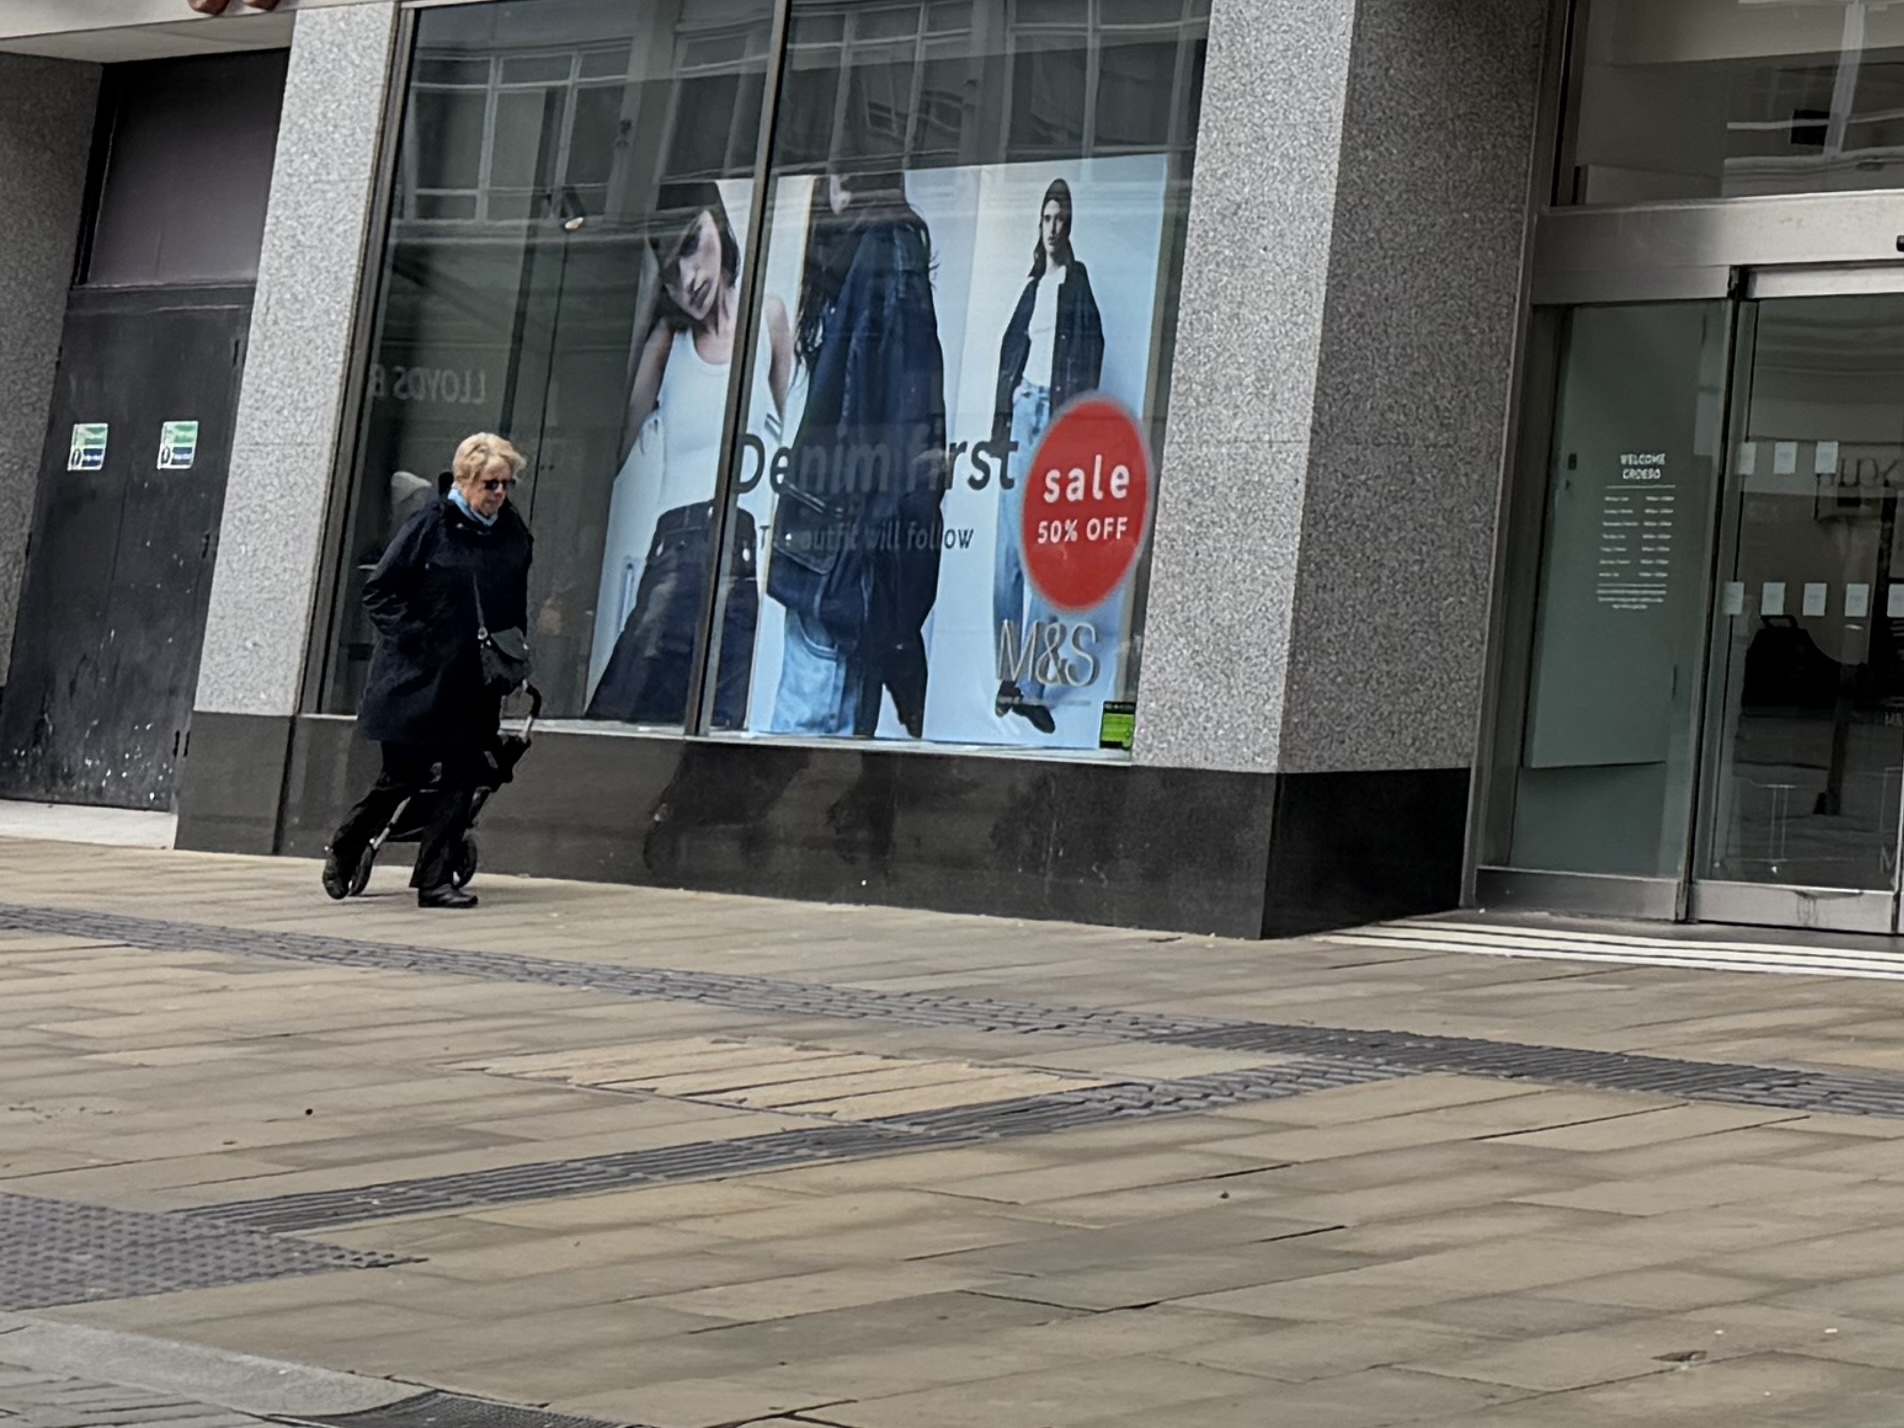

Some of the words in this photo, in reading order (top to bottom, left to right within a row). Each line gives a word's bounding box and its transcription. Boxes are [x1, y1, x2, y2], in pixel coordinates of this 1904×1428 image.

[733, 420, 892, 495] Denim
[906, 416, 1020, 491] first
[1041, 455, 1131, 505] sale
[906, 520, 976, 550] follow
[1036, 517, 1080, 544] 50%
[1086, 516, 1128, 542] OFF
[995, 617, 1102, 689] M&S
